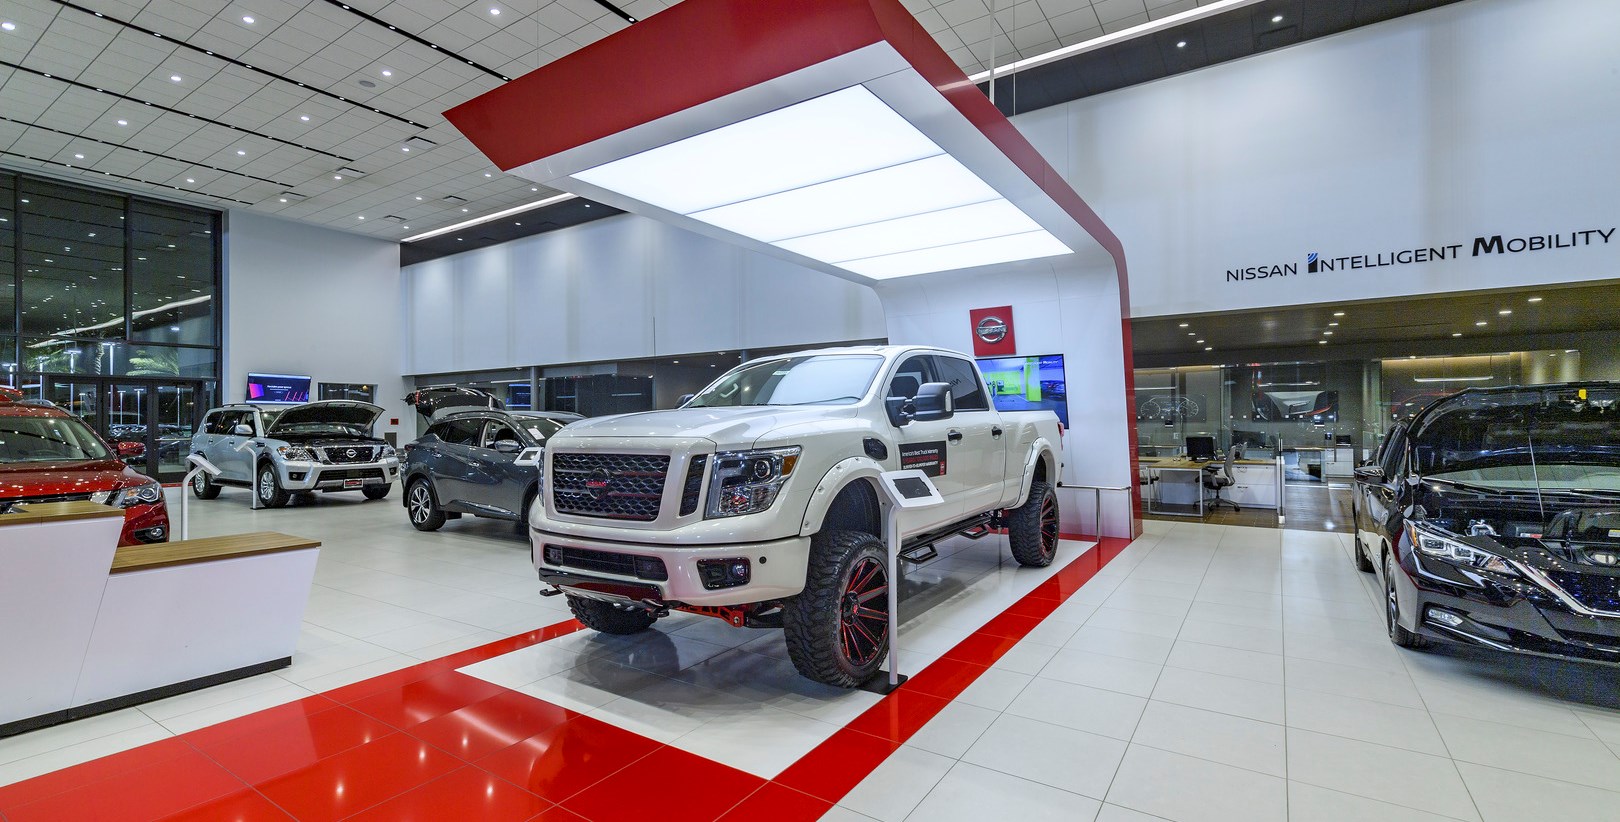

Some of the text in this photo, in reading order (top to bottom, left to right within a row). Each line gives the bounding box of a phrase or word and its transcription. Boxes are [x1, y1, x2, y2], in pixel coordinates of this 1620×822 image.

[1226, 227, 1616, 282] NISSAN INTELLIGENT MOBILITY
[977, 326, 1006, 334] NISSAN
